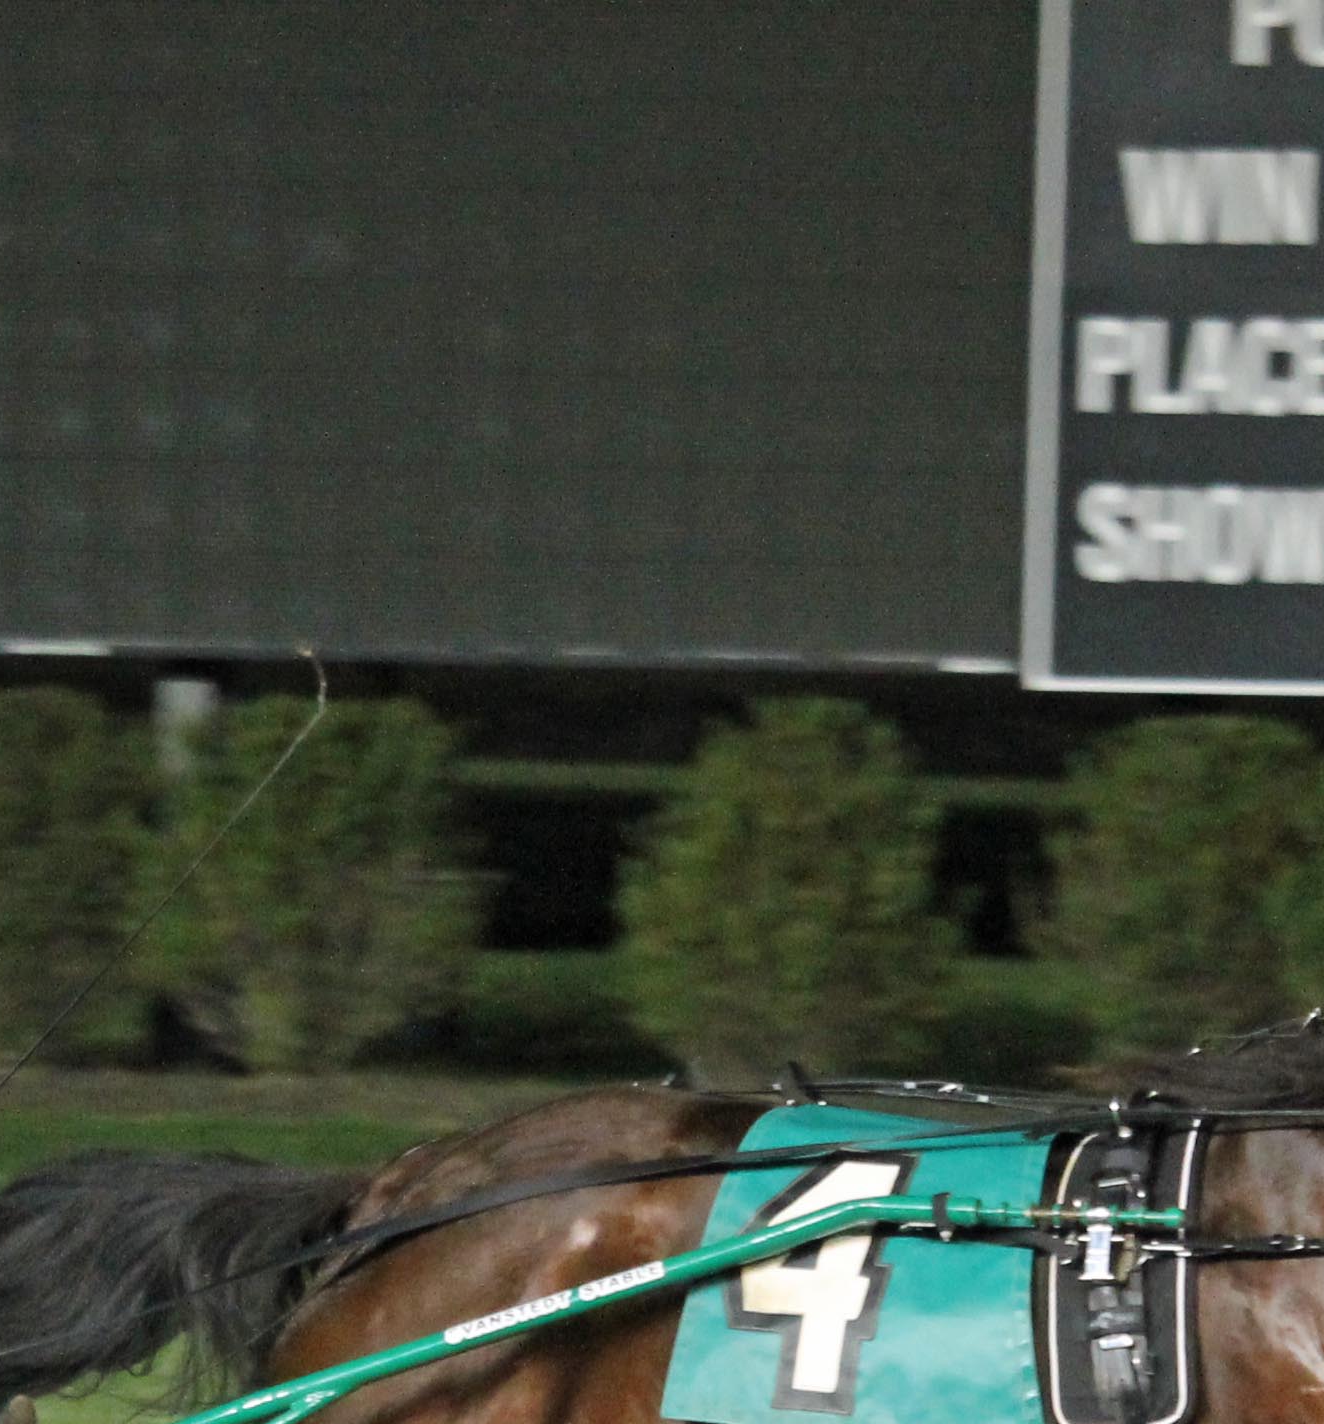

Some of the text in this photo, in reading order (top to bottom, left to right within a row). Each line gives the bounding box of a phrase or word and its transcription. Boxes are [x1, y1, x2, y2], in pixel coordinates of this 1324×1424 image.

[1118, 149, 1321, 246] WIN
[444, 1260, 666, 1345] VANSTEDT STABLE
[734, 1156, 906, 1400] 4
